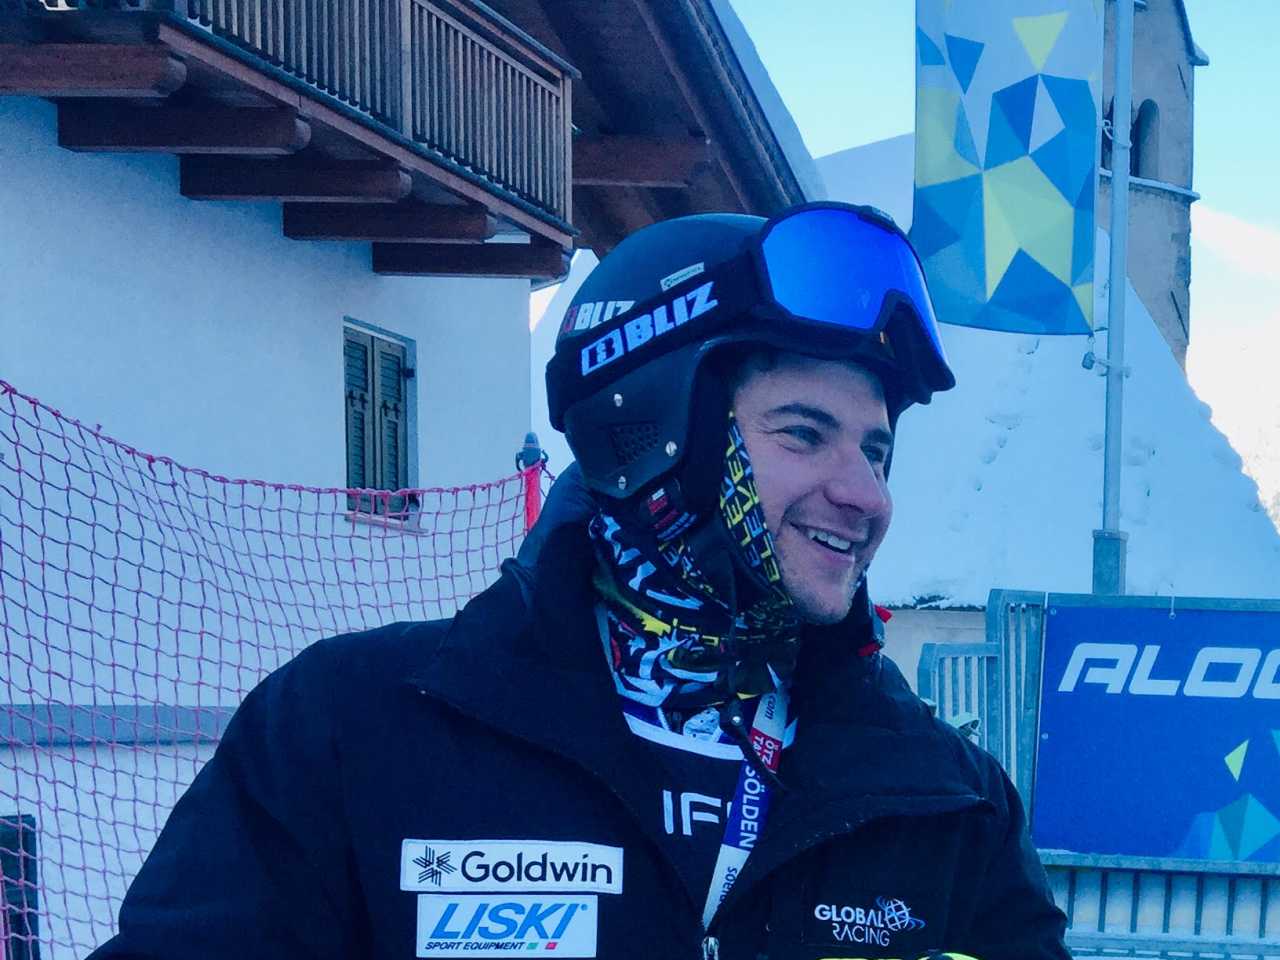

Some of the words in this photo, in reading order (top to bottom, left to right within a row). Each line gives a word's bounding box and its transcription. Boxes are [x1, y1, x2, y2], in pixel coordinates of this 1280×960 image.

[624, 281, 718, 352] BLIZ
[663, 789, 732, 836] IF
[461, 850, 613, 884] Goldwin
[429, 902, 581, 940] LISKI
[814, 904, 885, 928] GLOBAL
[425, 942, 462, 950] SPORT
[463, 942, 526, 950] EQUIPMENT
[831, 922, 890, 947] RACING
